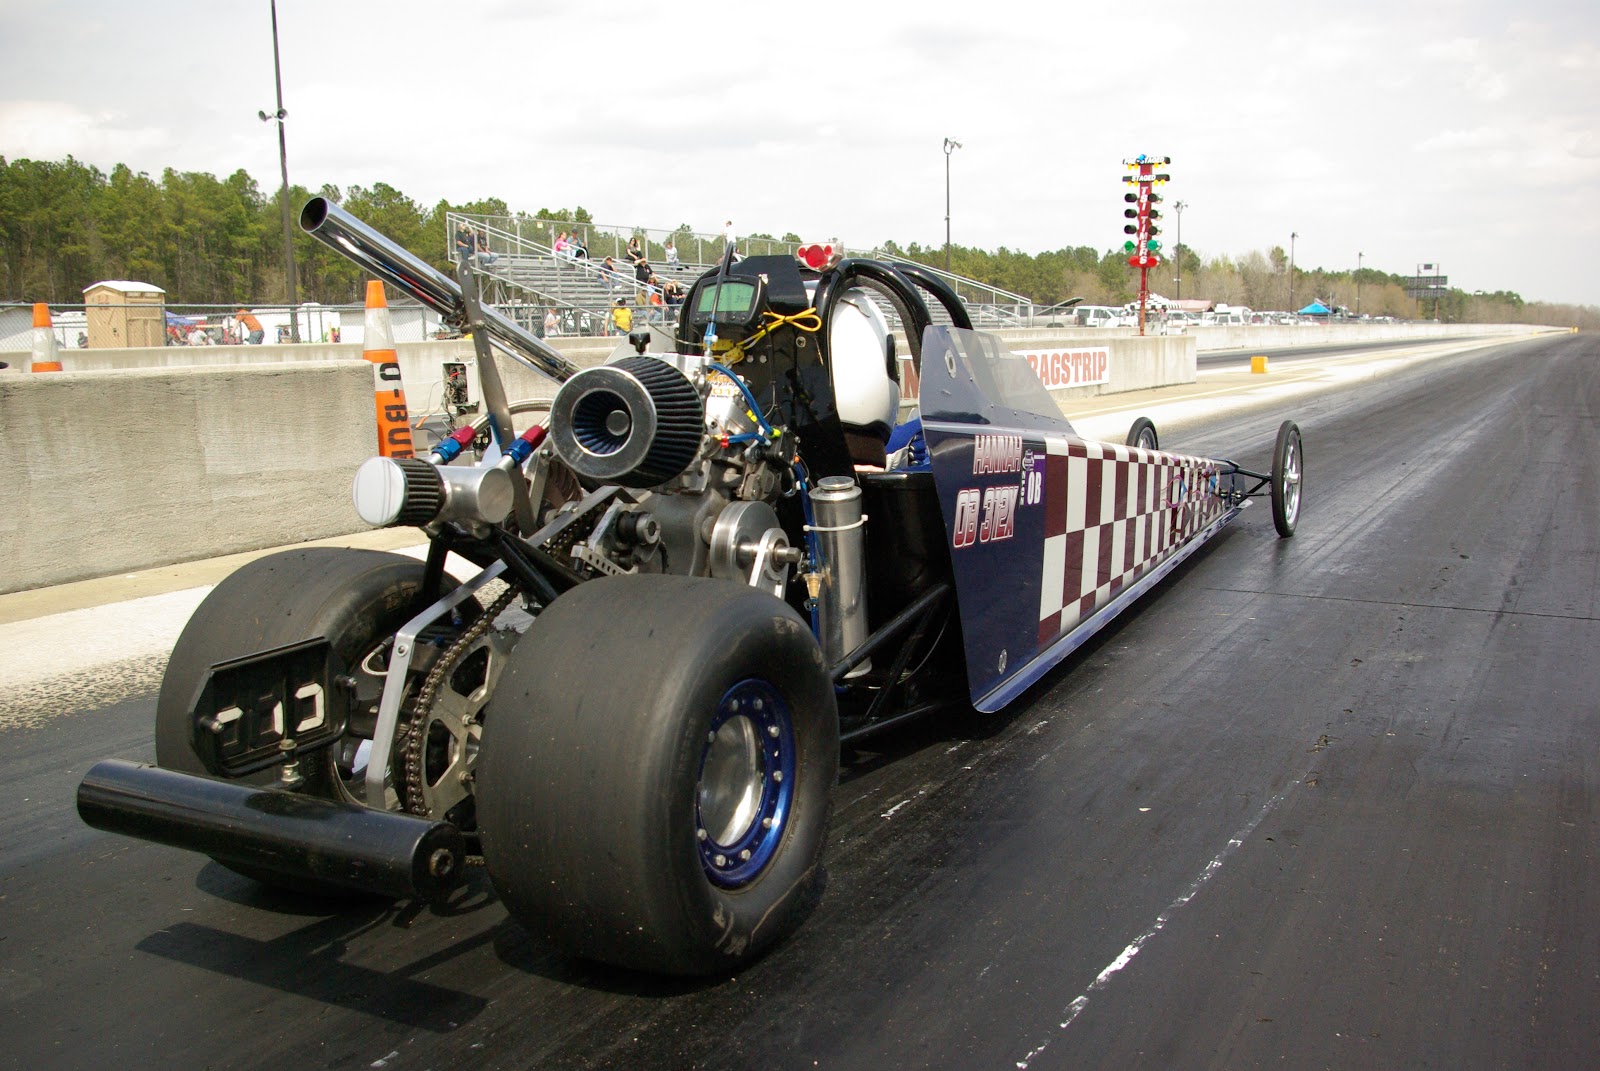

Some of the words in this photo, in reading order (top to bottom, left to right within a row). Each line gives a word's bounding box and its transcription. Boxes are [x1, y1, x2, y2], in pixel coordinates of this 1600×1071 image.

[1131, 174, 1156, 182] STAGED
[1140, 186, 1149, 211] TSI
[1139, 216, 1149, 265] TIMERS
[973, 434, 1022, 475] HANNAH
